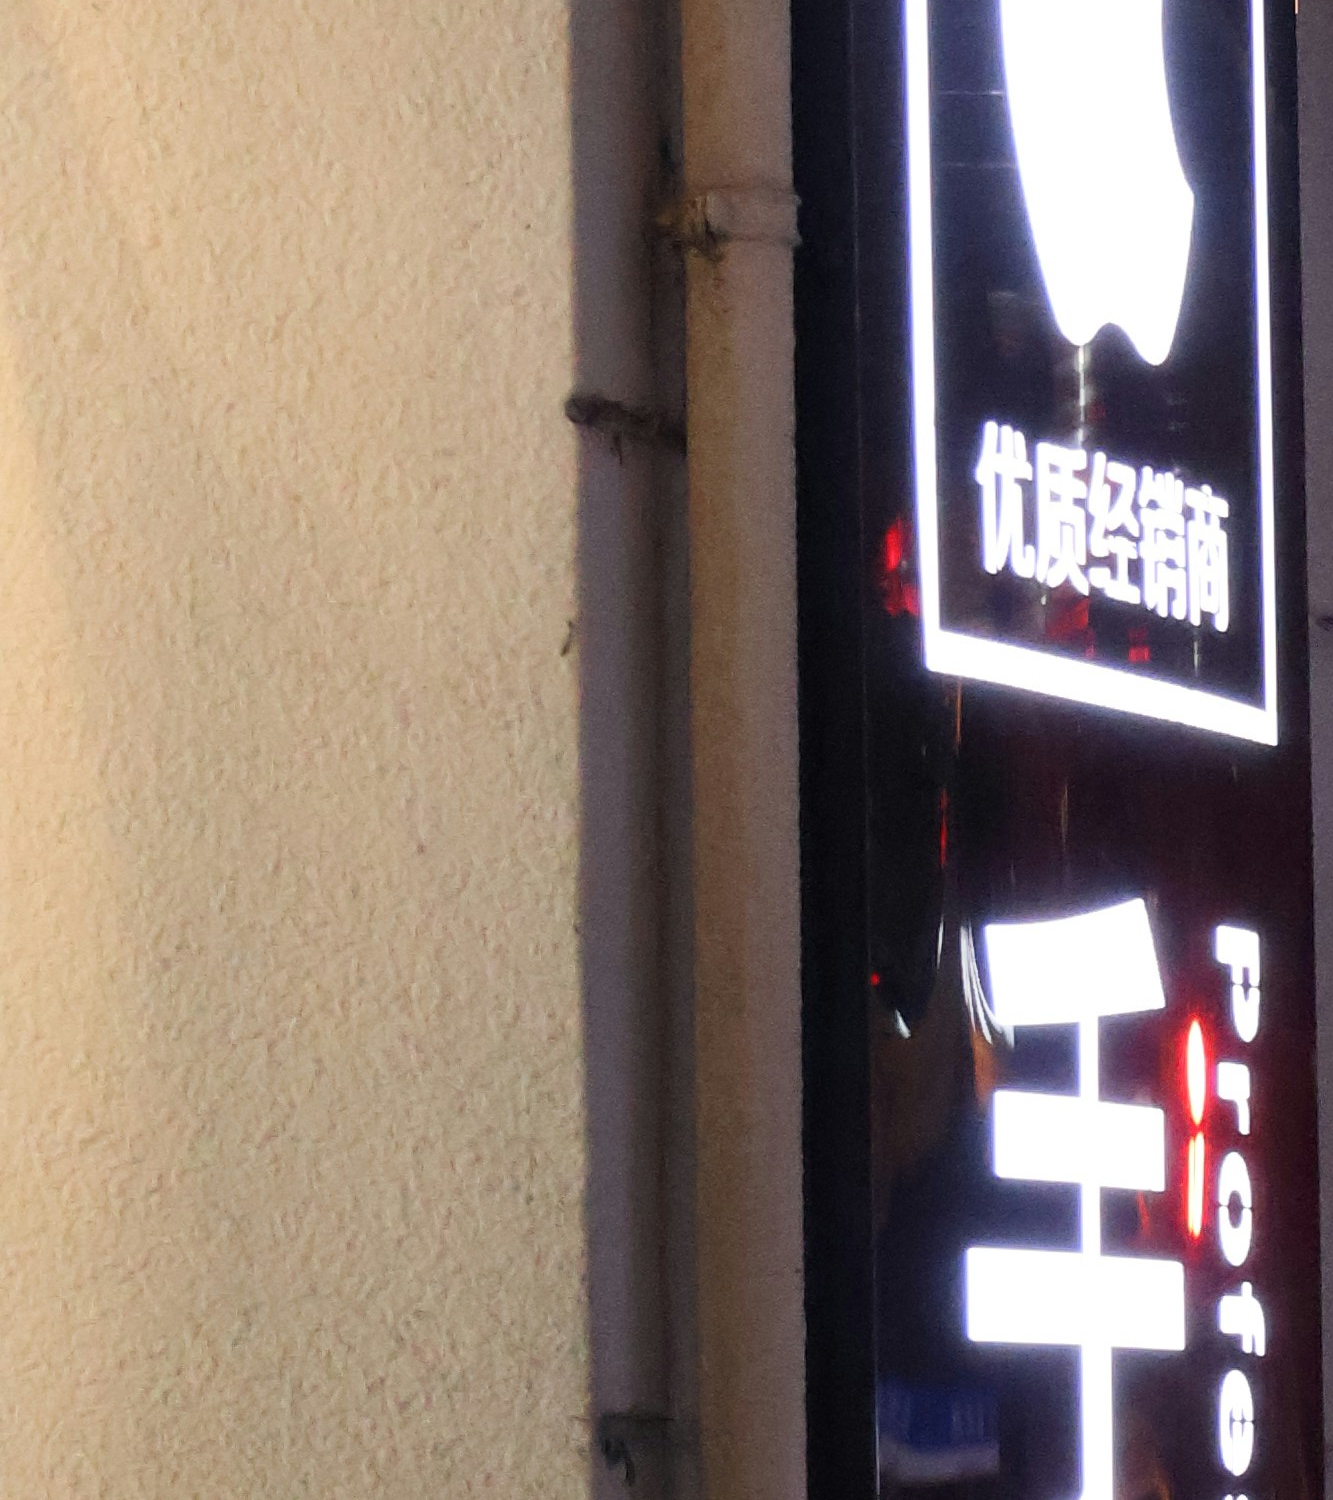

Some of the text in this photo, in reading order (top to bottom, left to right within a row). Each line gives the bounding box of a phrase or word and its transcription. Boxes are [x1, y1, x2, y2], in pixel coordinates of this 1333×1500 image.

[975, 419, 1230, 633] 优质经销商
